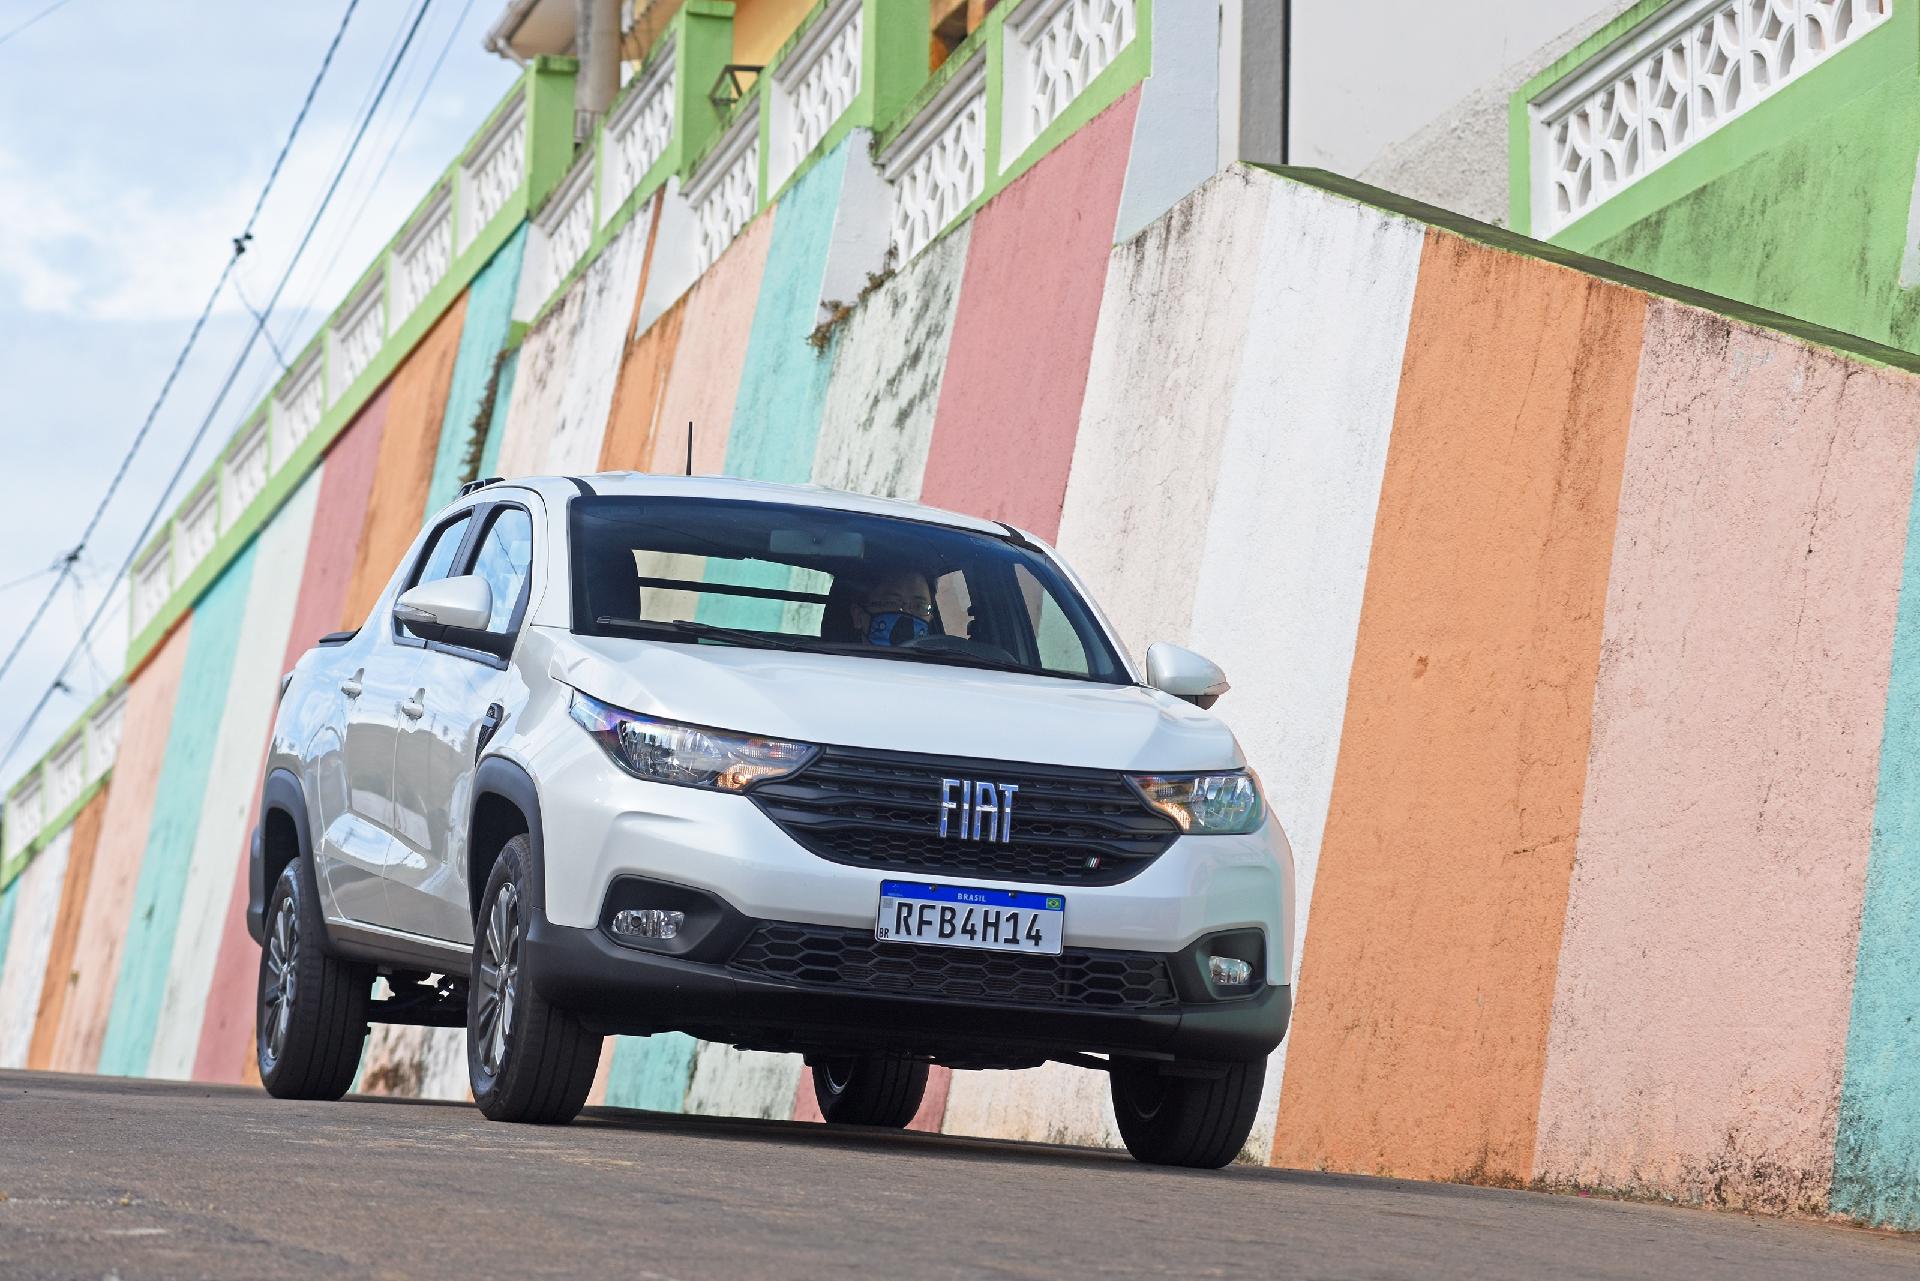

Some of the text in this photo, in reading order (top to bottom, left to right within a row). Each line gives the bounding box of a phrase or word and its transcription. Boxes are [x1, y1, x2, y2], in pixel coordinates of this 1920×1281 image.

[939, 778, 1019, 843] FIAT
[957, 892, 987, 903] BRASIL
[879, 927, 890, 939] BR
[895, 901, 1043, 947] RFB4H14
